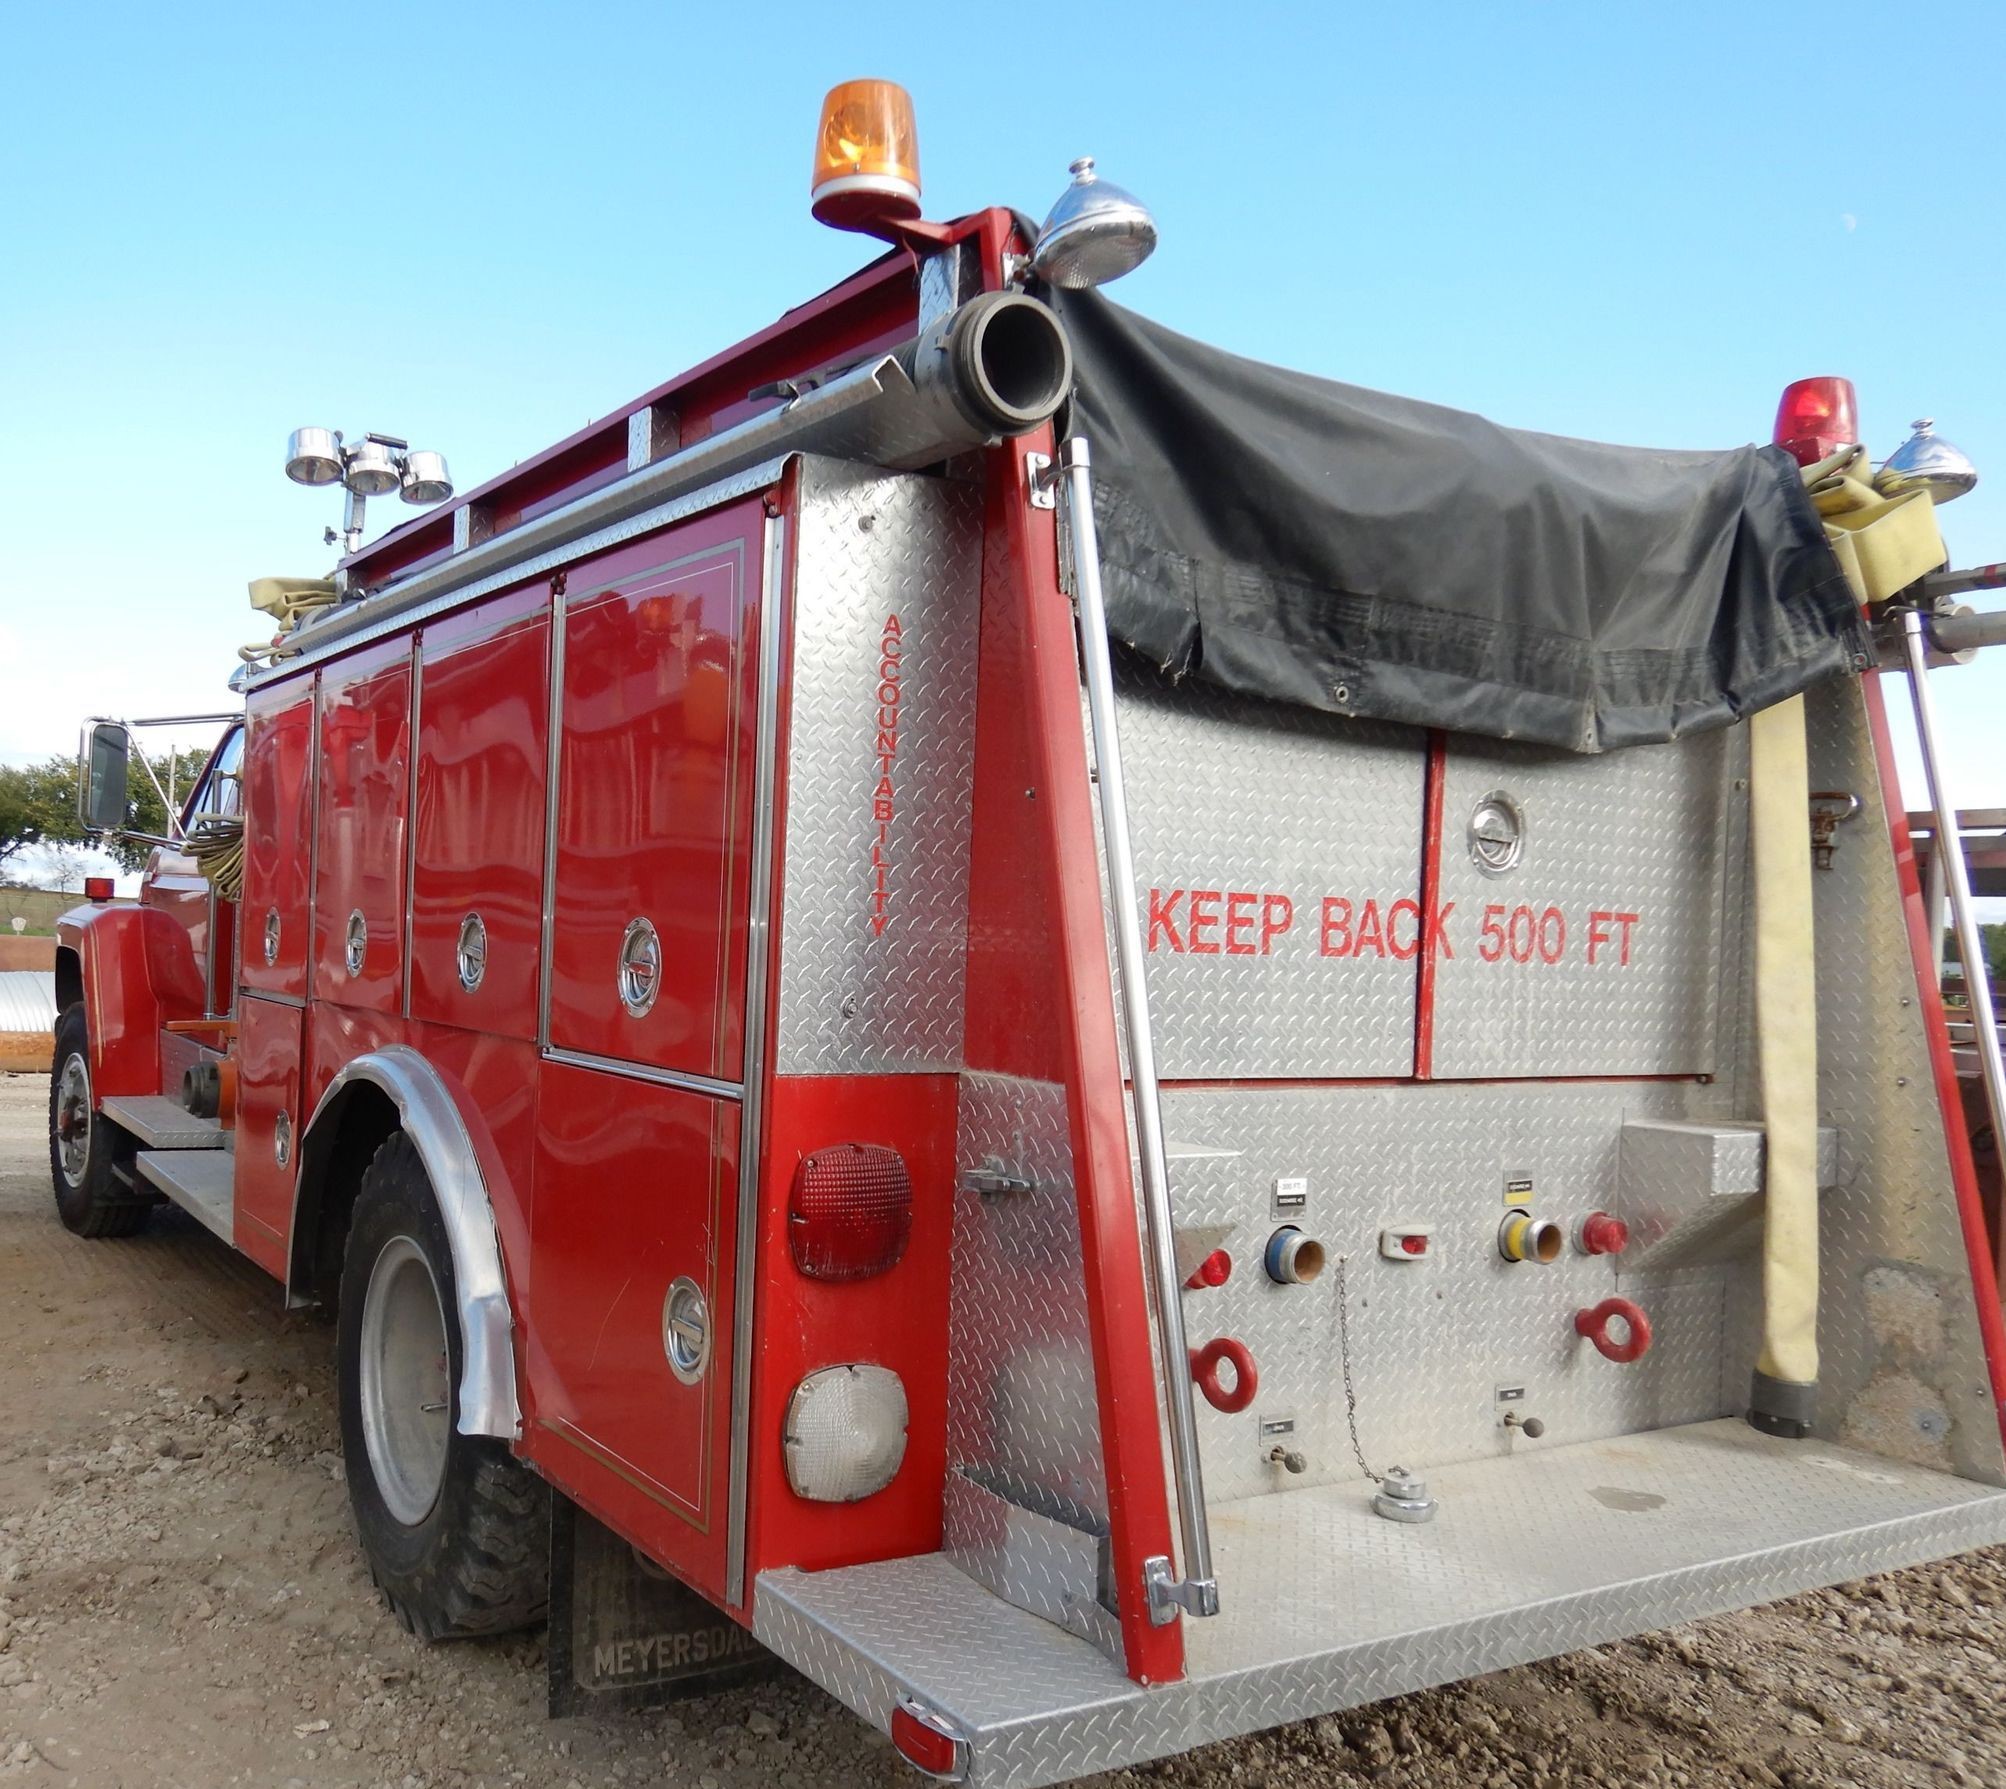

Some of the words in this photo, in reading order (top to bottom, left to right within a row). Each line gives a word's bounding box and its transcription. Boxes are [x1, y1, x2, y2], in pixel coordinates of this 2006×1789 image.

[871, 614, 902, 937] ACCOUNTABILITY
[1148, 889, 1292, 955] KEEP
[1320, 897, 1456, 962] BACK
[1479, 905, 1566, 966] 500
[1587, 911, 1639, 967] FT
[595, 1627, 759, 1677] MEYERSDAL
